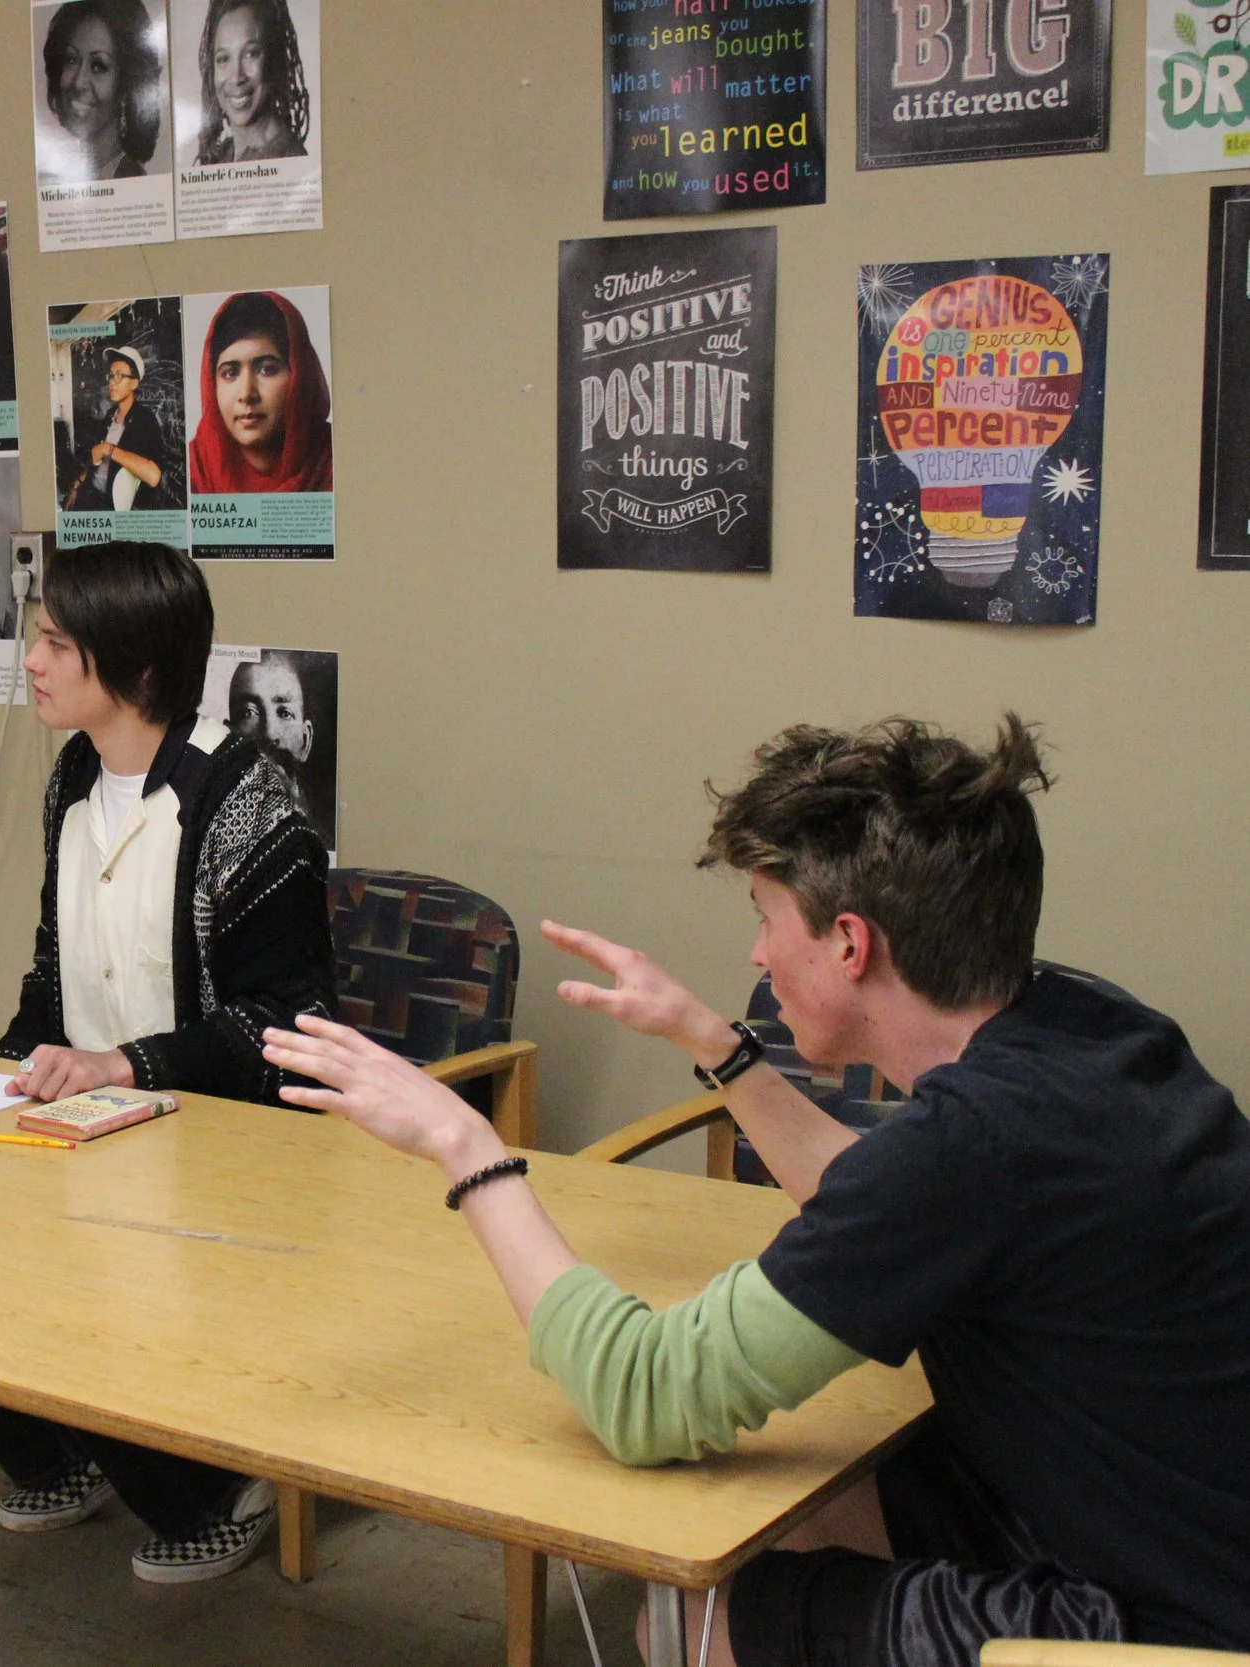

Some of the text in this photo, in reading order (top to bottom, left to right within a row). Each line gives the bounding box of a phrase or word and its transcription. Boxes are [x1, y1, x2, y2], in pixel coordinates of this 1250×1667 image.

[610, 34, 624, 47] or
[649, 24, 711, 50] jeans
[716, 18, 815, 58] you bought.
[892, 0, 1071, 88] BIG
[611, 65, 811, 99] What will matter
[617, 103, 683, 124] is what
[893, 79, 1069, 122] difference!
[631, 112, 808, 157] you learned
[180, 164, 278, 185] Kimberlé Crenshaw
[612, 162, 819, 195] and how you used it.
[40, 186, 115, 202] Michelle Obama
[603, 265, 665, 301] Think
[582, 282, 751, 353] POSITIVE
[901, 318, 1071, 353] is one percent
[886, 345, 1069, 388] inspiration
[580, 360, 750, 452] POSITIVE
[887, 385, 933, 407] AND
[618, 444, 709, 491] things
[63, 518, 112, 528] VANESSA
[191, 502, 237, 514] MALALA
[191, 517, 257, 529] YOUSAFZAI
[617, 495, 717, 524] WILL HAPPEN
[63, 532, 112, 543] NEWMAN
[215, 649, 237, 659] History
[238, 651, 258, 659] Month
